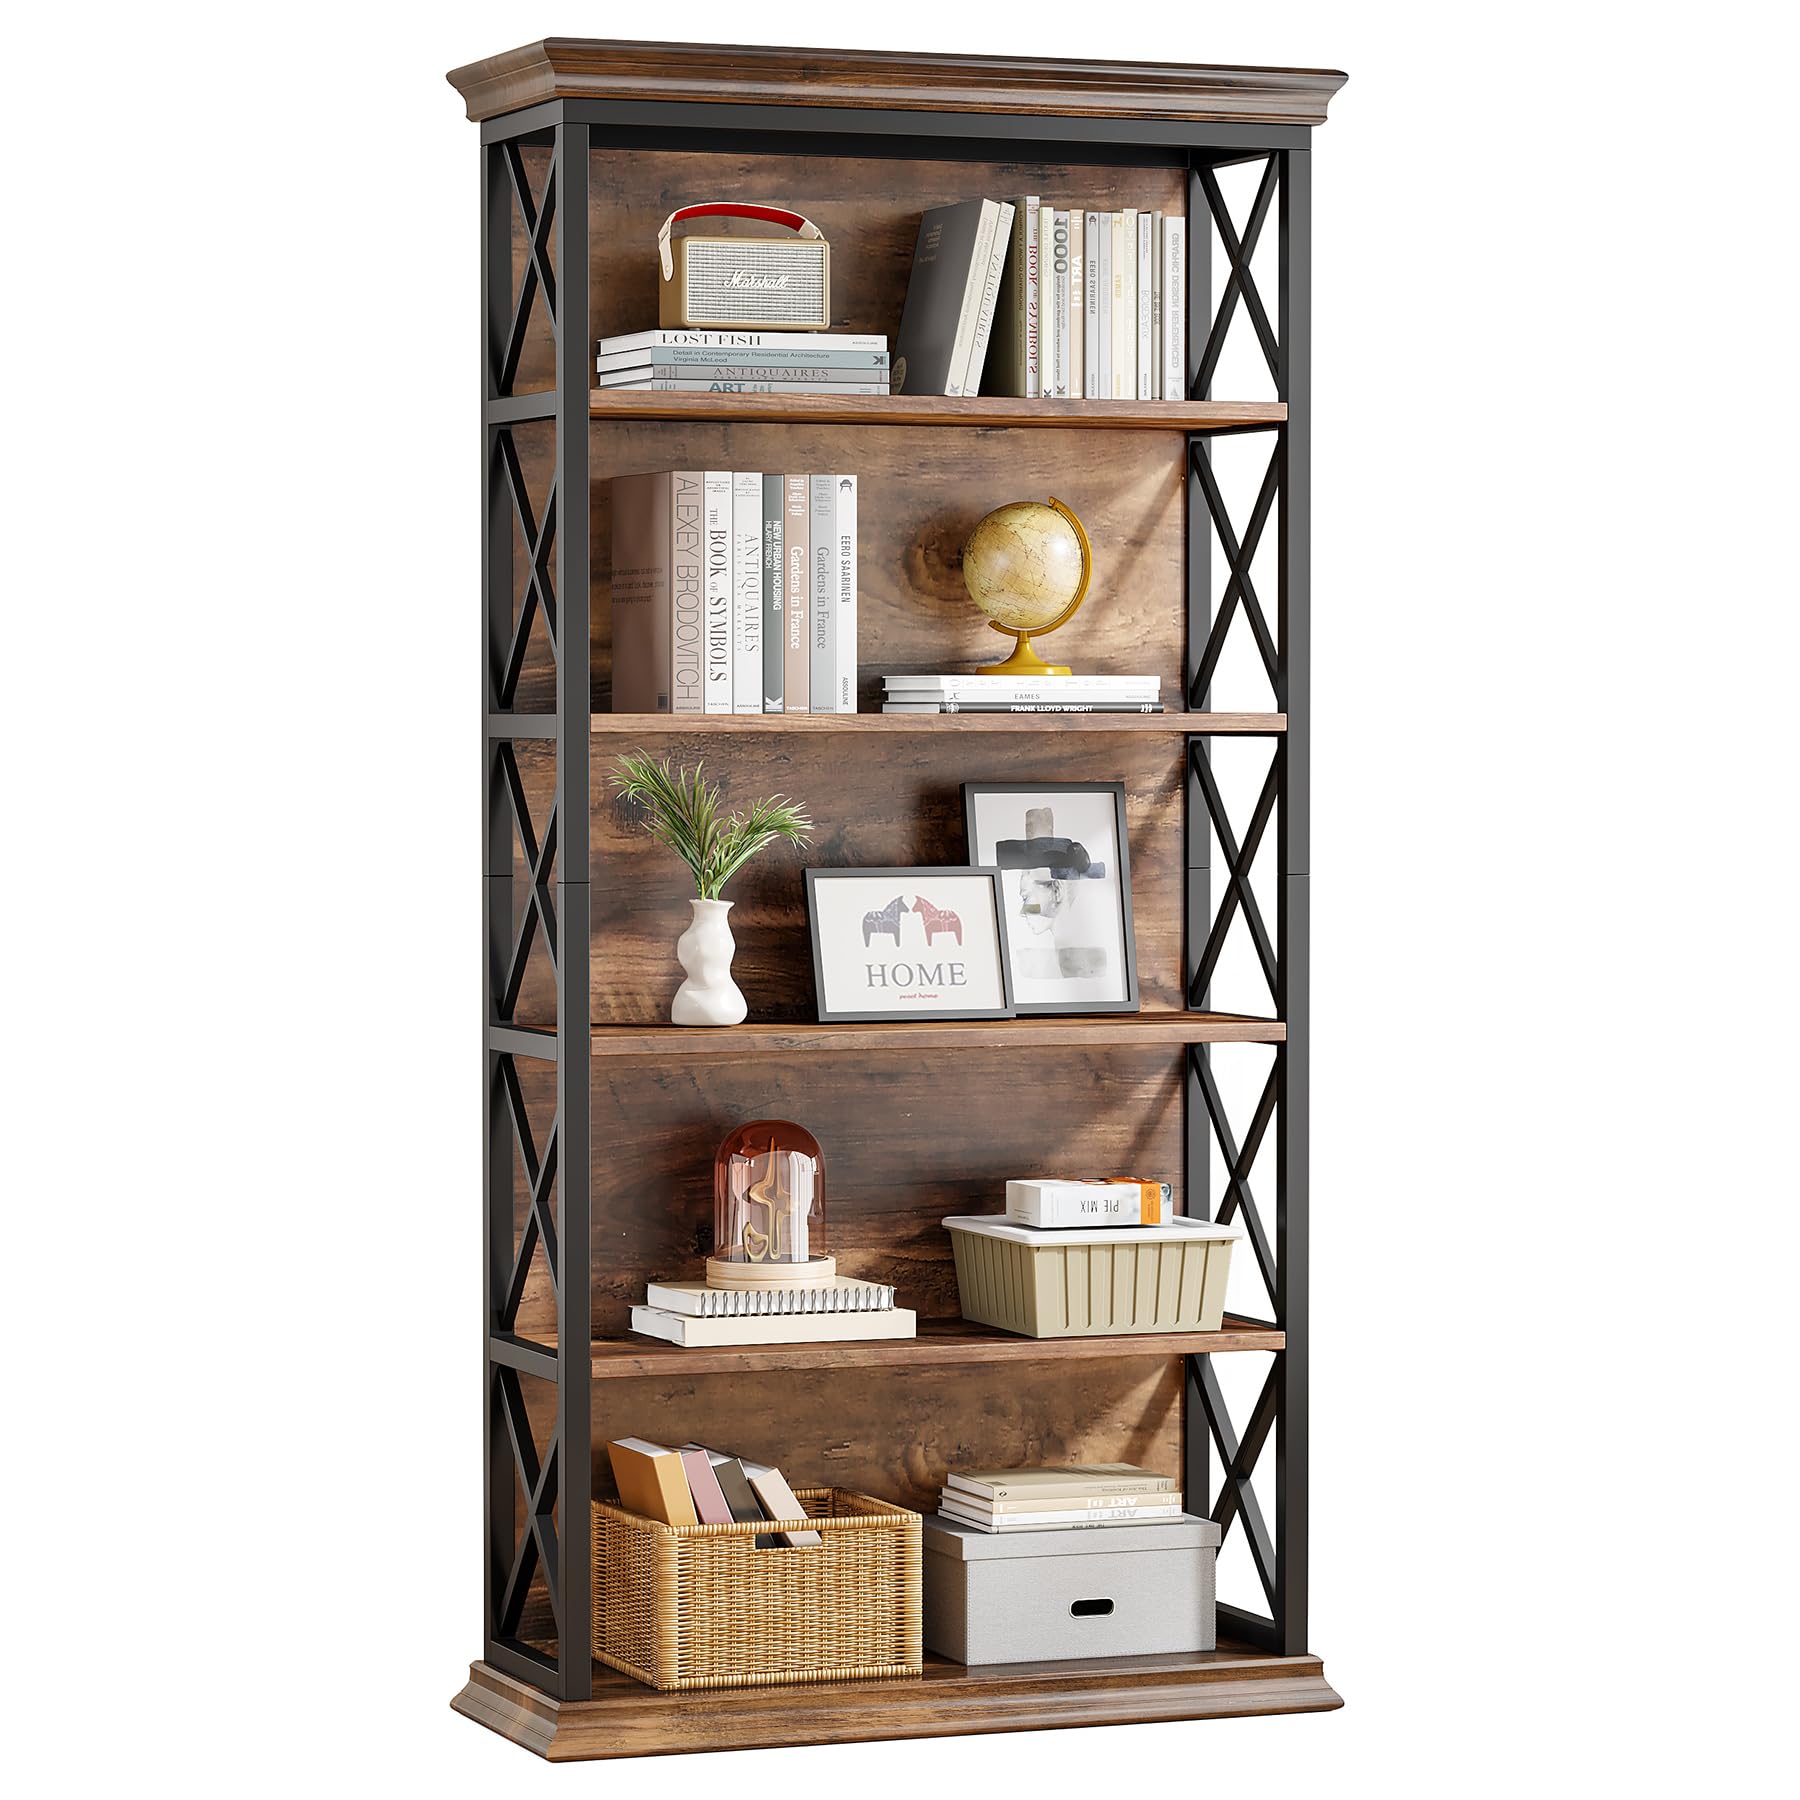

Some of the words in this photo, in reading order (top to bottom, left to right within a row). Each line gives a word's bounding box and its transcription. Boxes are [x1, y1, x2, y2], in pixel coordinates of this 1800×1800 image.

[722, 270, 789, 288] Marshall
[662, 333, 712, 345] LOST
[719, 334, 761, 346] FISH
[701, 350, 750, 358] Contemporary
[713, 367, 829, 377] ANTIQUAIRES
[709, 382, 746, 393] ART
[676, 477, 700, 558] ALEXEY
[710, 508, 718, 525] THE
[765, 520, 773, 543] HILARY
[773, 520, 782, 541] NEW
[710, 529, 728, 578] BOOK
[765, 543, 773, 569] FRENCH
[773, 541, 782, 571] URBAN
[841, 535, 851, 557] EERO
[790, 546, 804, 594] Gardens
[817, 546, 830, 594] Gardens
[710, 581, 718, 593] OF
[773, 572, 782, 611] HOUSING
[841, 560, 851, 603] SAARINEN
[741, 534, 760, 652] ANTIQUAIRES
[790, 596, 804, 607] in
[817, 596, 830, 607] in
[676, 565, 700, 699] BRODOVITCH
[710, 596, 727, 682] SYMBOLS
[790, 610, 804, 649] France
[817, 610, 830, 649] France
[865, 963, 968, 987] HOME
[1080, 1200, 1098, 1213] MIX
[1104, 1199, 1120, 1213] PIE
[1110, 1496, 1138, 1508] ART
[1110, 1508, 1138, 1518] ART
